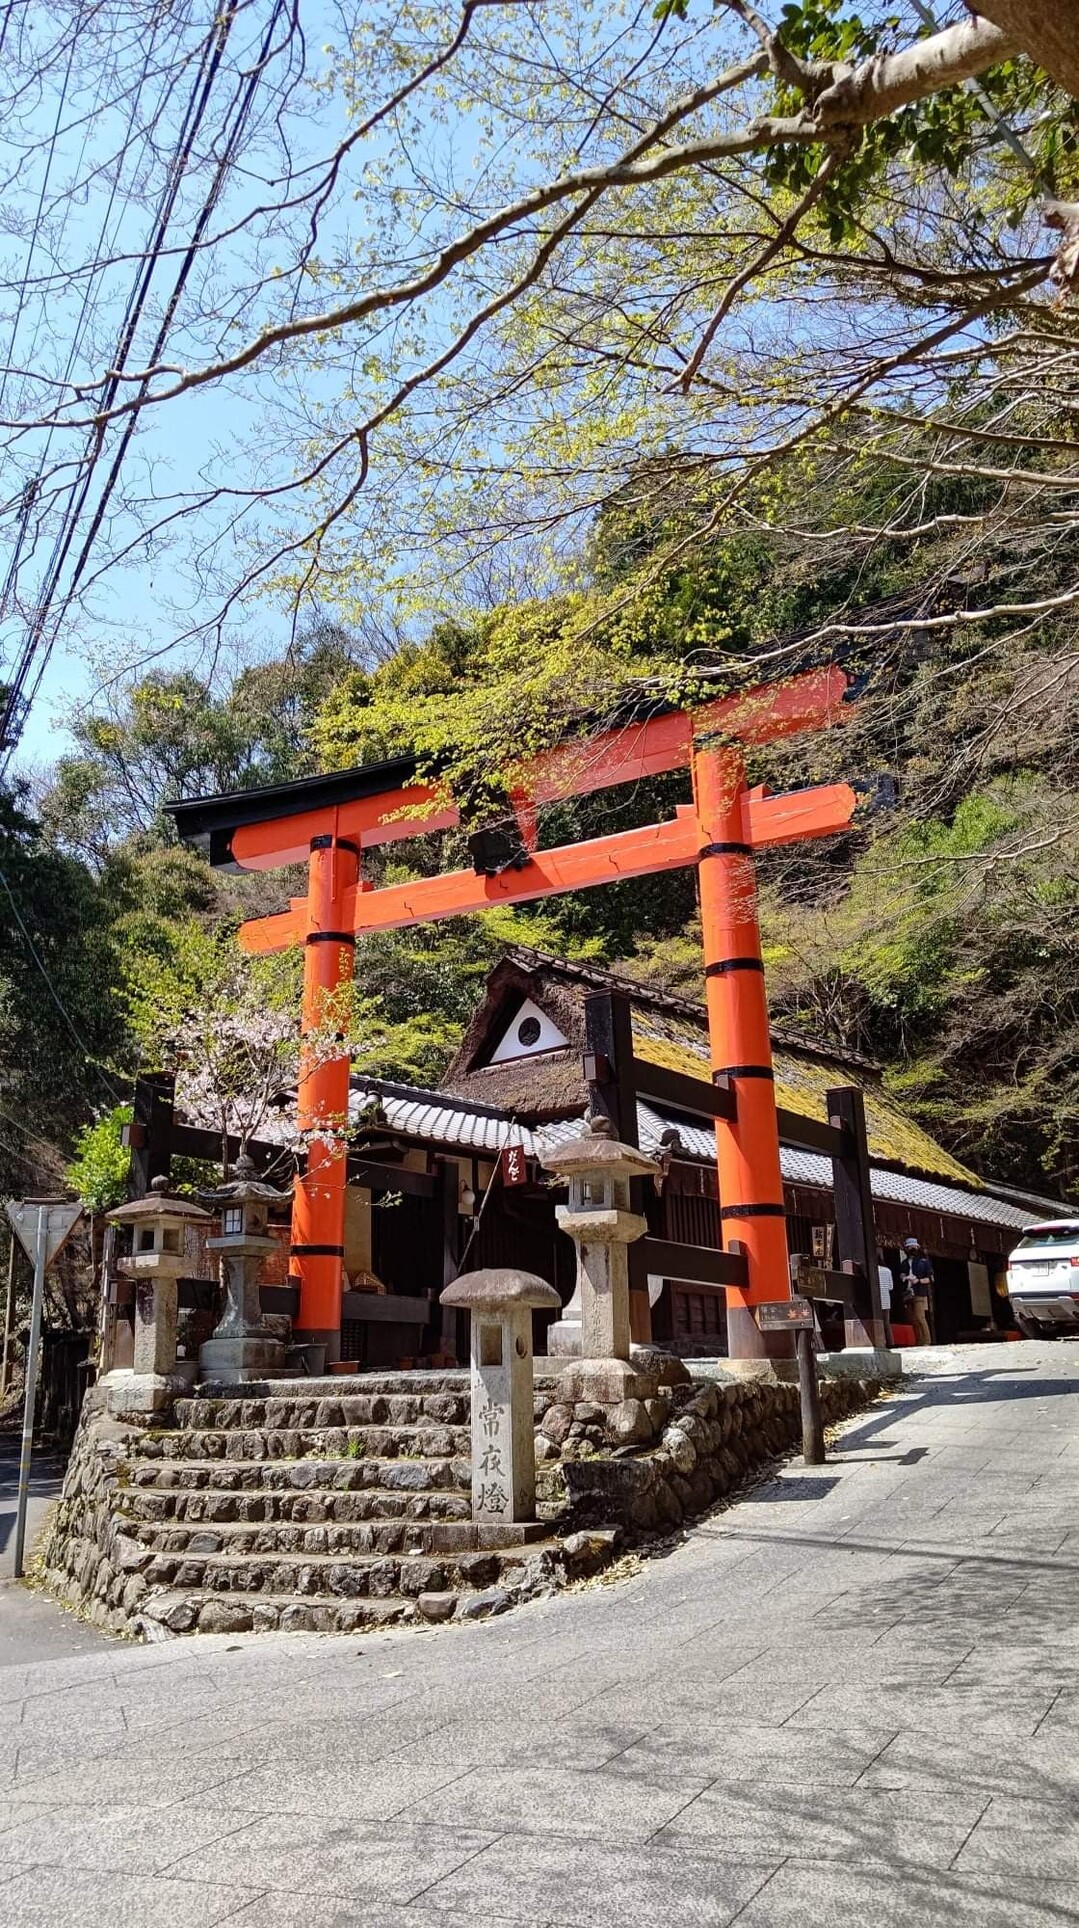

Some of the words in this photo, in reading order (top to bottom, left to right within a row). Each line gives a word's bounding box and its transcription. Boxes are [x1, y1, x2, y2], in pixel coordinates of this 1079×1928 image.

[508, 1149, 520, 1182] だんご
[476, 1398, 509, 1514] 常夜燈
